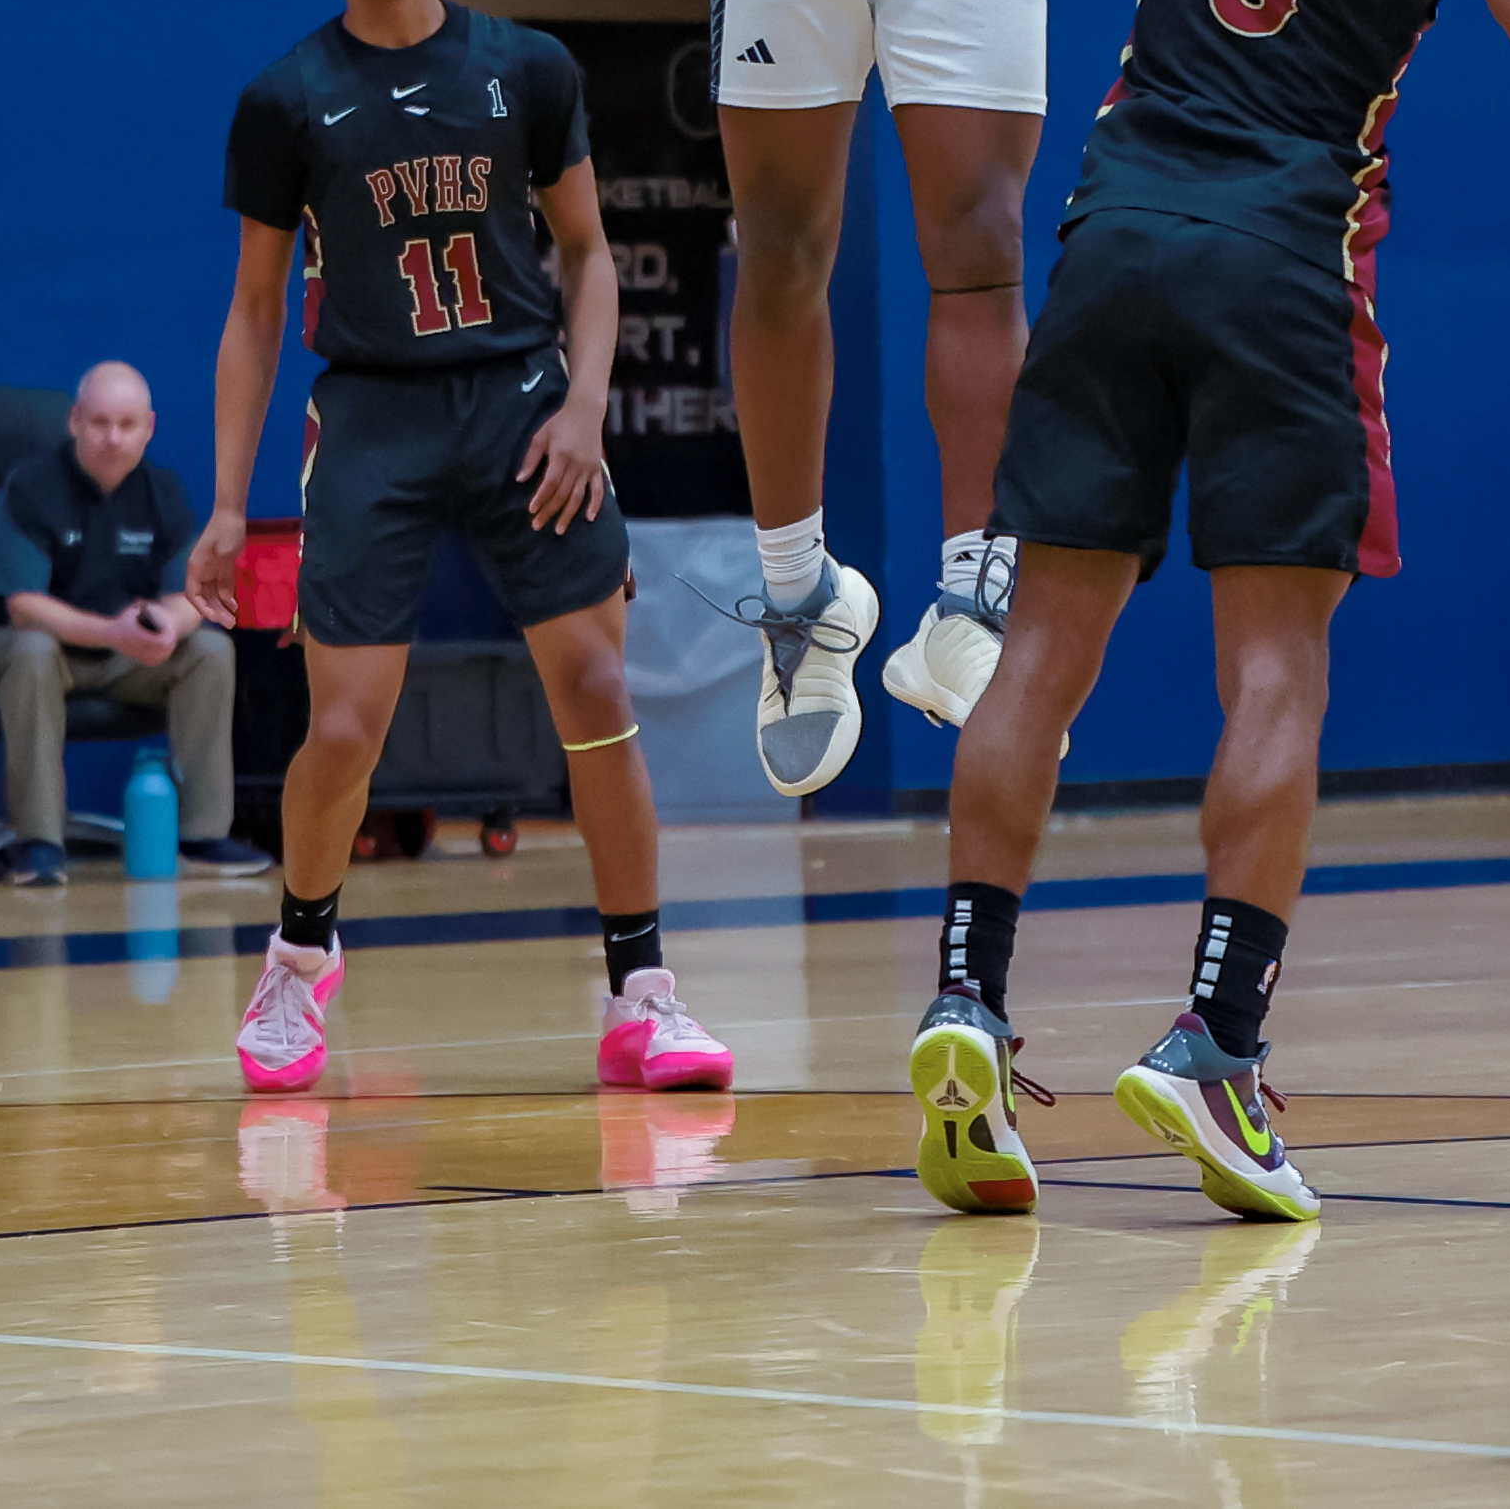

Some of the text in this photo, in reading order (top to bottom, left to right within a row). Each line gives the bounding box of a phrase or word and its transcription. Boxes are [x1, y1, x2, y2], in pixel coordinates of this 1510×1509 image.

[487, 78, 508, 118] 1
[365, 154, 492, 228] PVHS
[398, 232, 493, 336] 11
